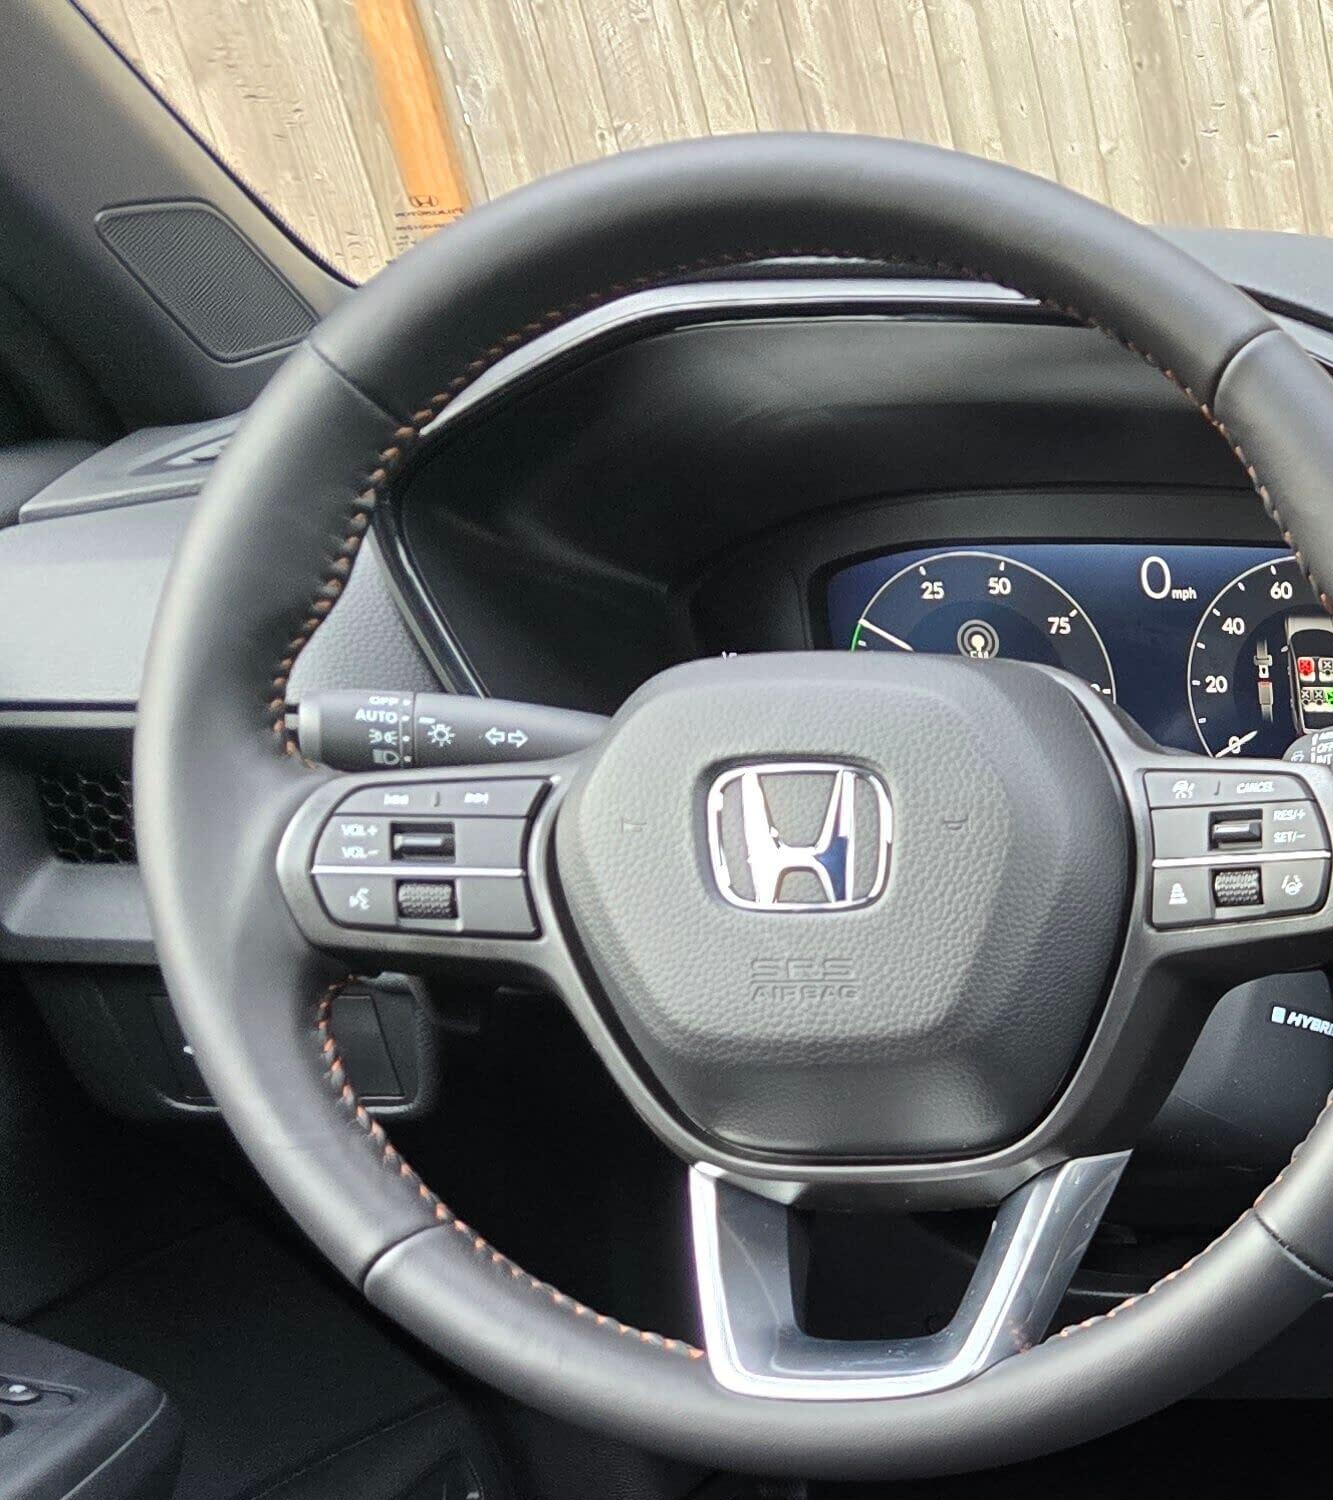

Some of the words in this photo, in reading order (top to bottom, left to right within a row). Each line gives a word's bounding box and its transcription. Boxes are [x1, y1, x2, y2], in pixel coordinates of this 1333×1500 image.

[988, 577, 1011, 596] 50
[1141, 556, 1171, 600] 0
[1171, 587, 1197, 601] mph
[921, 581, 944, 599] 25
[1270, 581, 1293, 600] 60
[1047, 617, 1071, 635] 75
[1221, 617, 1245, 635] 40
[1205, 676, 1227, 693] 20
[355, 708, 397, 724] AUTO
[1236, 781, 1274, 794] CANCEL
